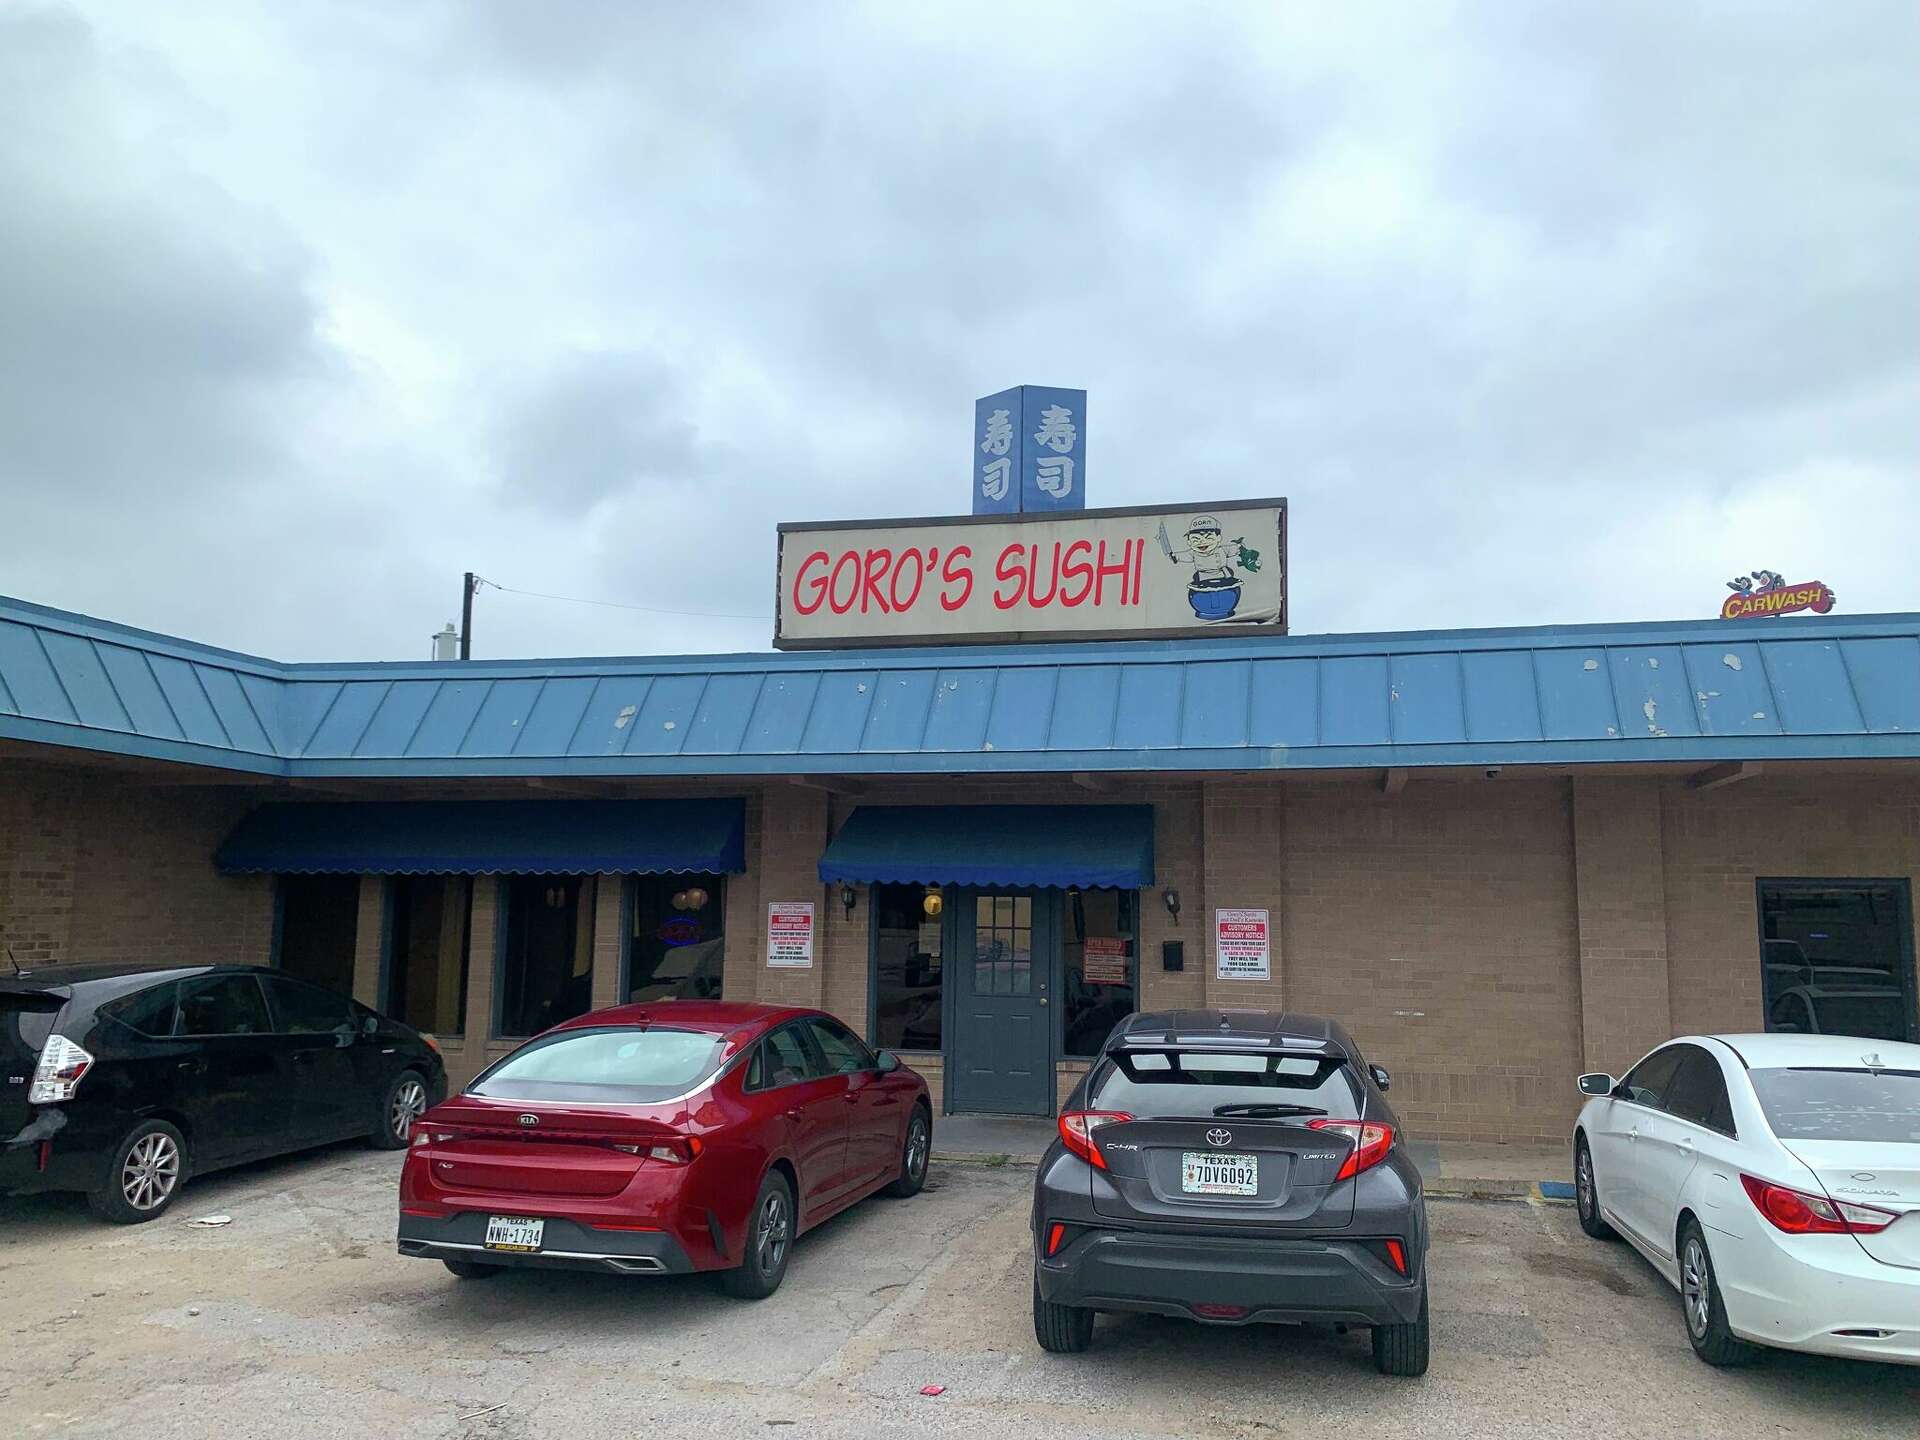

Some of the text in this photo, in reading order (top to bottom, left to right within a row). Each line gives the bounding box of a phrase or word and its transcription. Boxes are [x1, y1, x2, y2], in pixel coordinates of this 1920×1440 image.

[980, 408, 1014, 501] 寿司
[1034, 404, 1077, 499] 寿司
[793, 538, 1145, 615] GORO'S SUSHI
[520, 1116, 536, 1125] KIA
[1106, 1143, 1138, 1151] C-HR
[1204, 1157, 1237, 1166] TEXAS
[1196, 1166, 1253, 1185] 7DV6092
[505, 1218, 528, 1226] TEXAS
